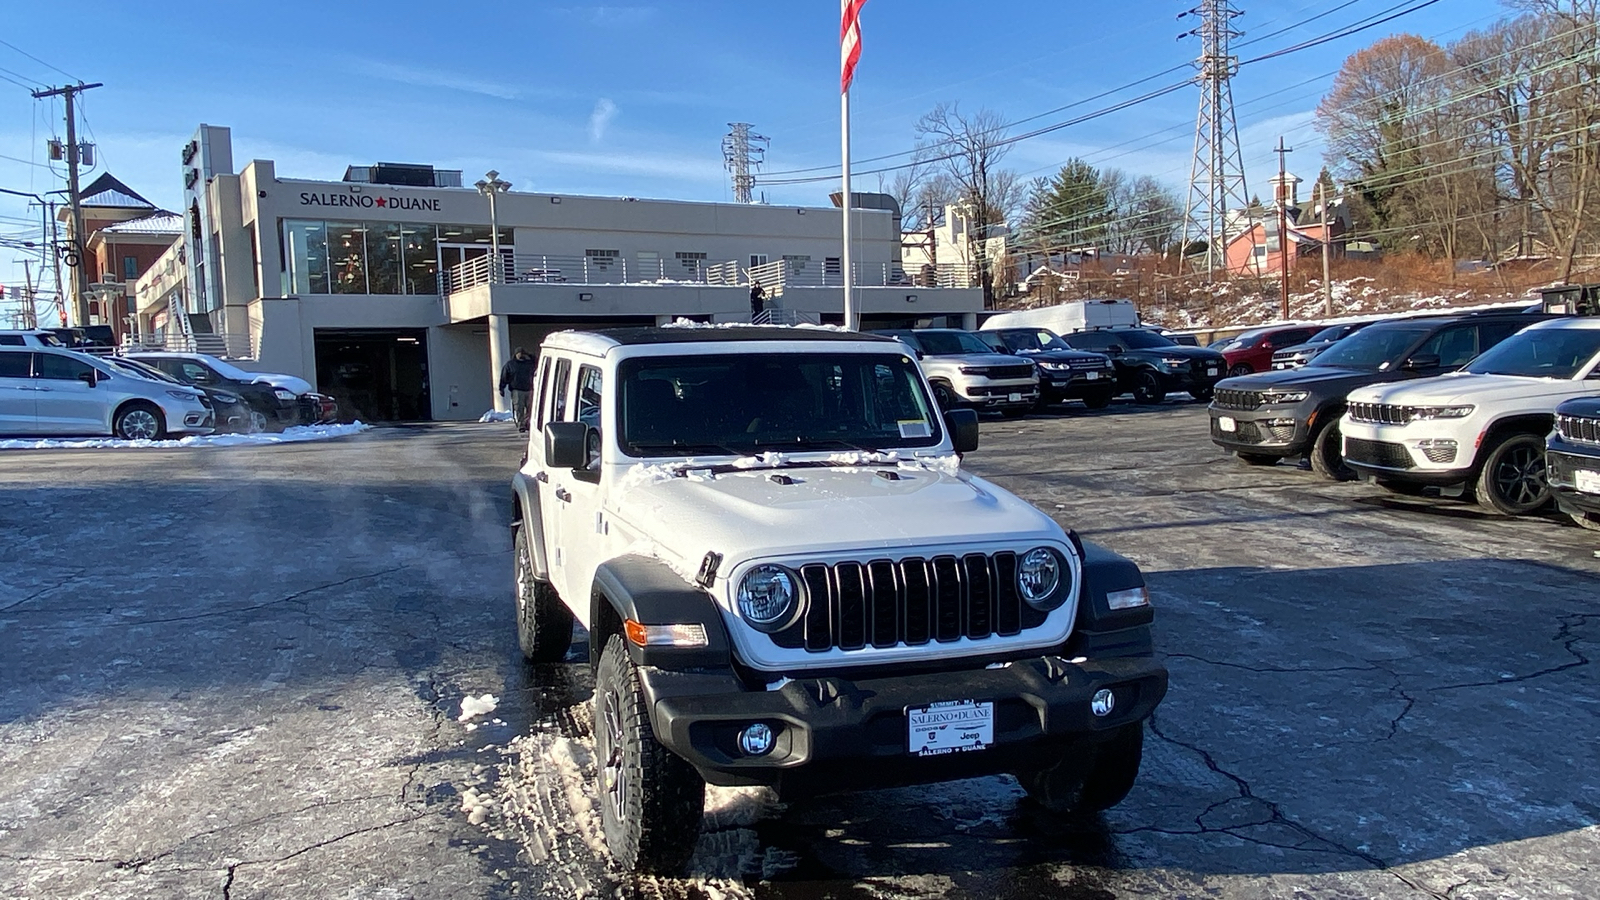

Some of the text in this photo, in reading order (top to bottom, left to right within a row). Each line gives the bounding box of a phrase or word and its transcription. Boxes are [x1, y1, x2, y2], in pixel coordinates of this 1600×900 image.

[300, 192, 441, 211] SALERNO DUANE
[911, 712, 954, 724] SALERNO
[959, 708, 991, 719] DUANE
[960, 732, 980, 740] Jeep
[919, 744, 986, 757] SALERNO DUANE
